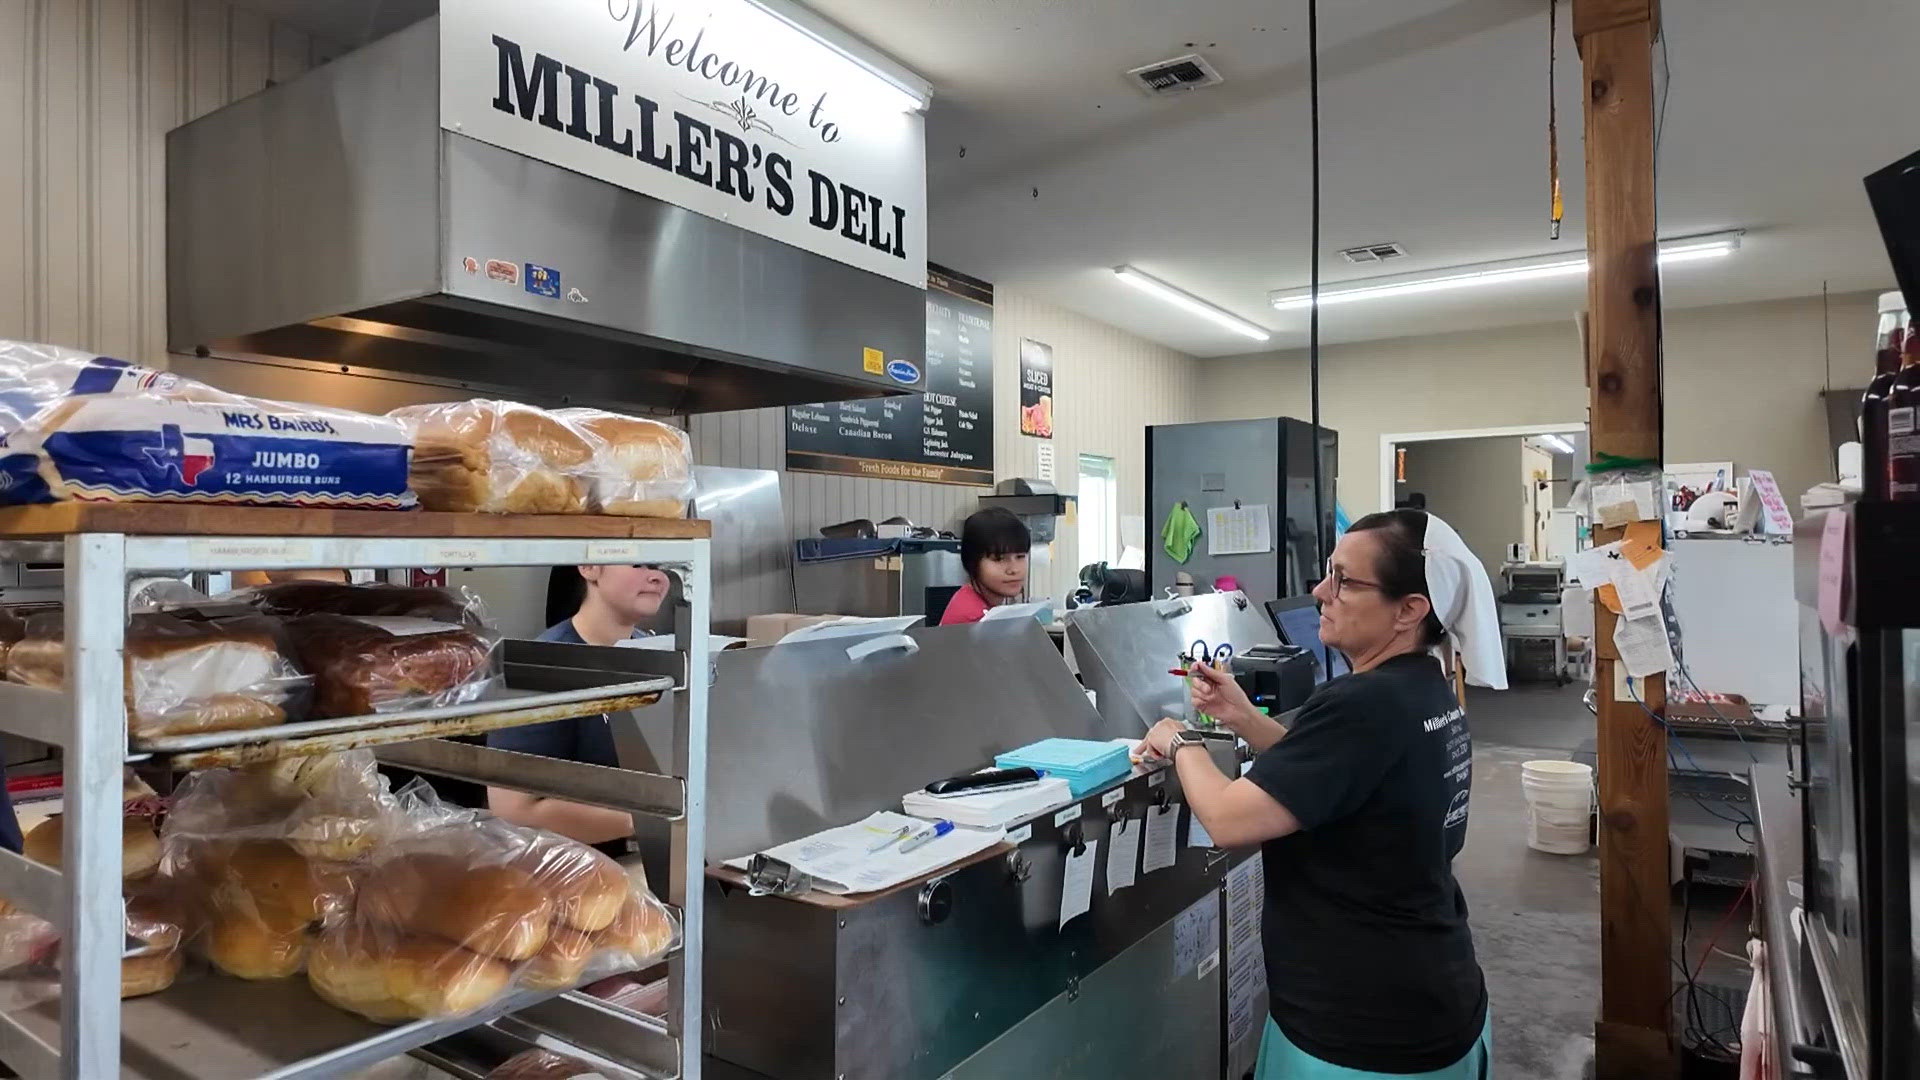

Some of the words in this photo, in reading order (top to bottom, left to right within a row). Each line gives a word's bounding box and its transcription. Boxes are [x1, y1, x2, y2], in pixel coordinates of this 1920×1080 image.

[607, 0, 800, 116] Welcome
[811, 91, 842, 144] to
[491, 33, 796, 217] MILLER'S
[807, 168, 908, 260] DELI
[1026, 368, 1049, 387] SLICED
[923, 392, 935, 404] HOT
[935, 394, 957, 407] CHEESE
[222, 411, 264, 430] MRS
[791, 421, 818, 435] Deluxe
[838, 426, 872, 439] Canadian
[872, 430, 893, 441] Bacon
[252, 450, 320, 469] JUMBO
[225, 472, 242, 485] 12
[244, 474, 312, 485] HAMBURGER
[314, 475, 341, 485] BUNS
[880, 463, 900, 476] Foods
[900, 465, 910, 476] for
[911, 466, 922, 478] the
